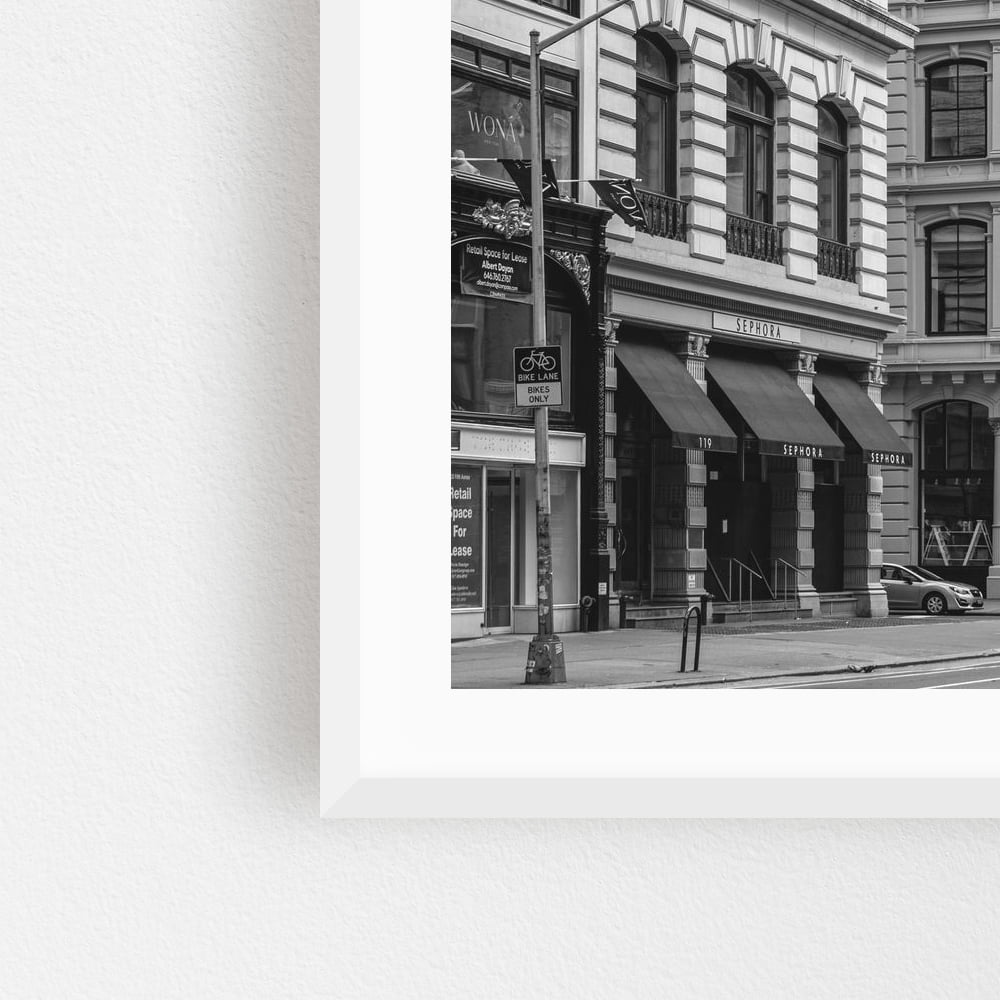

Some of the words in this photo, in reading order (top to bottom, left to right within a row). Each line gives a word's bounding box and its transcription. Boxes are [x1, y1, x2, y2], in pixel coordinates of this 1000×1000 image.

[467, 110, 516, 143] WONA
[466, 243, 483, 256] Retail
[484, 246, 501, 259] Space
[502, 249, 511, 260] for
[511, 251, 528, 264] Lease
[482, 260, 498, 271] Albert
[736, 317, 781, 338] SEPHORA
[517, 373, 536, 382] BIKE
[537, 372, 559, 381] LANE
[527, 385, 551, 394] BIKES
[528, 395, 549, 403] ONLY
[699, 437, 712, 448] 119
[783, 444, 823, 458] SEPHORA
[871, 452, 905, 464] SEPHORA
[451, 508, 473, 521] pace
[453, 524, 467, 538] For
[451, 546, 473, 557] ease
